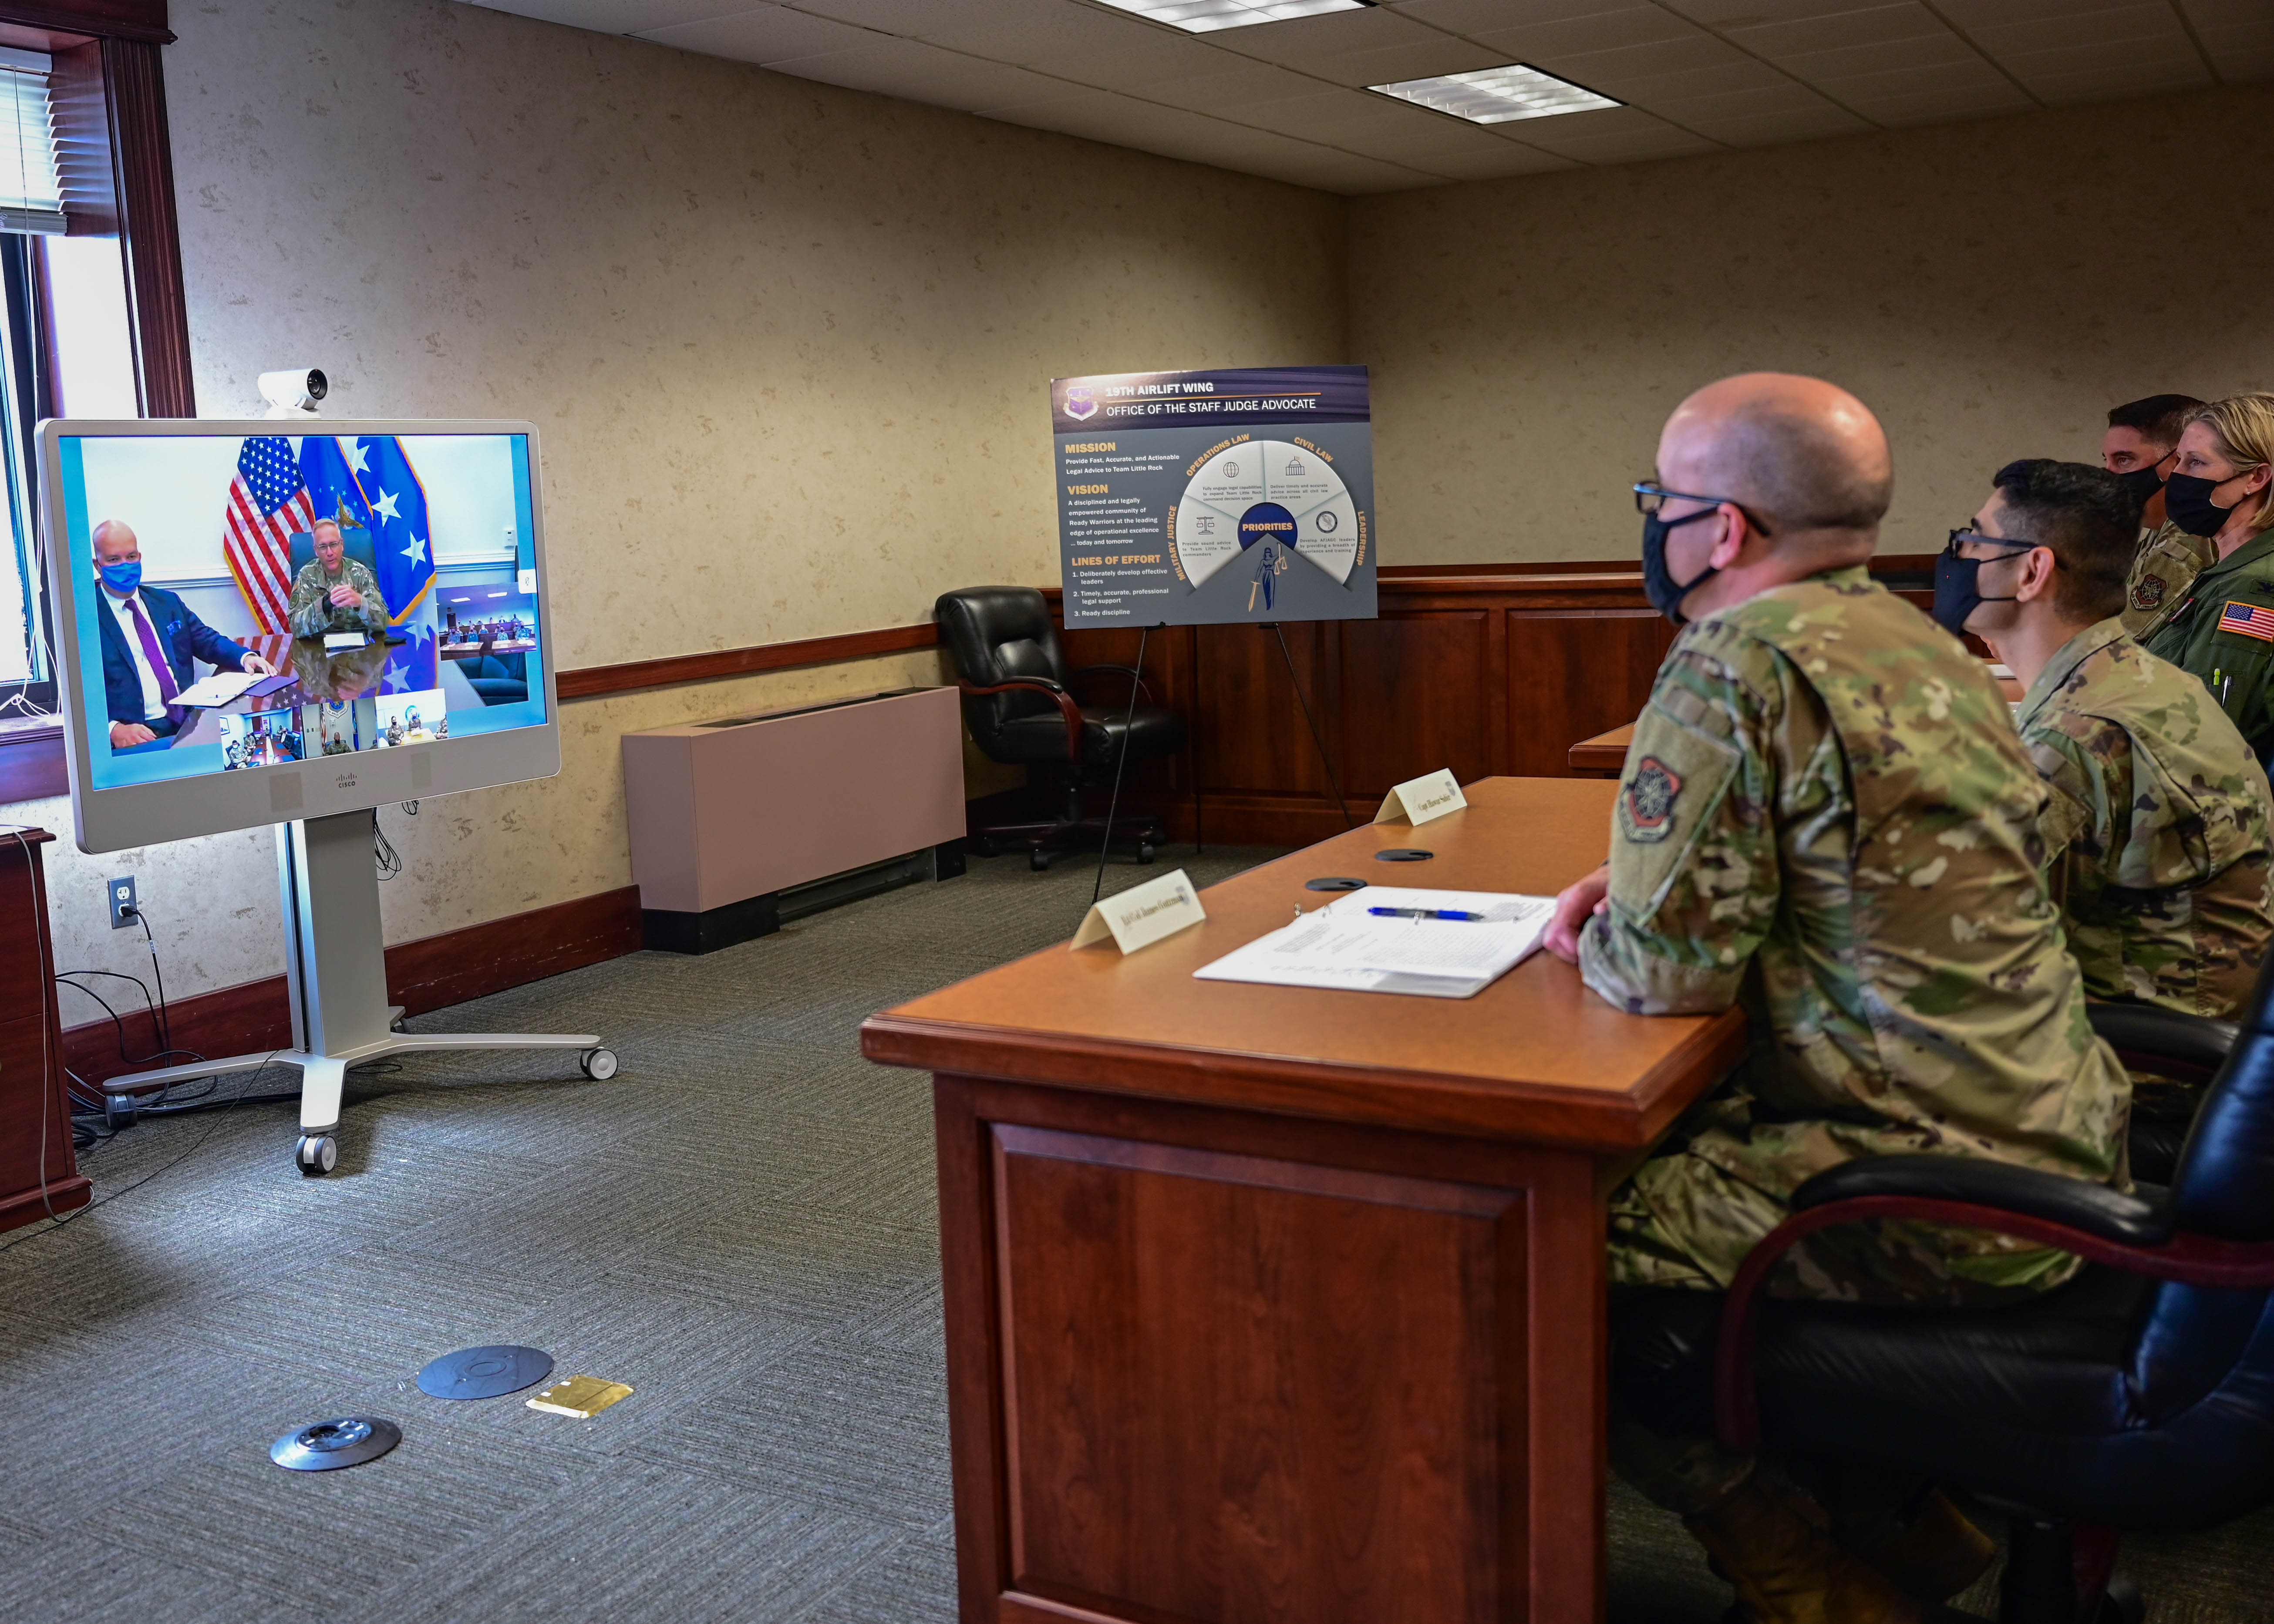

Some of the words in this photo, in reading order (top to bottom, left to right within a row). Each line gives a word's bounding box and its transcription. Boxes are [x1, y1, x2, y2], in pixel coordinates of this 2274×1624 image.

[1106, 386, 1134, 397] 19TH
[1137, 384, 1180, 395] AIRLIFT
[1182, 383, 1213, 393] WING
[1106, 405, 1145, 417] OFFICE
[1147, 404, 1162, 414] OF
[1164, 403, 1186, 414] THE
[1189, 402, 1221, 413] STAFF
[1223, 400, 1259, 411] JUDGE
[1261, 399, 1316, 410] ADVOCATE
[1065, 442, 1116, 454] MISSION
[1186, 440, 1231, 477] OPERATIONS
[1231, 434, 1250, 444] LAW
[1294, 437, 1315, 451] CIVIL
[1316, 447, 1334, 463] LAW
[1068, 484, 1108, 495] VISION
[1167, 505, 1177, 539] JUSTICE
[1242, 522, 1293, 531] PRIORITIES
[1356, 511, 1367, 566] LEADERSHIP
[1072, 557, 1102, 566] LINES
[1105, 556, 1119, 565] OF
[1122, 555, 1161, 564] EFFORT
[1168, 541, 1186, 581] MILITARY
